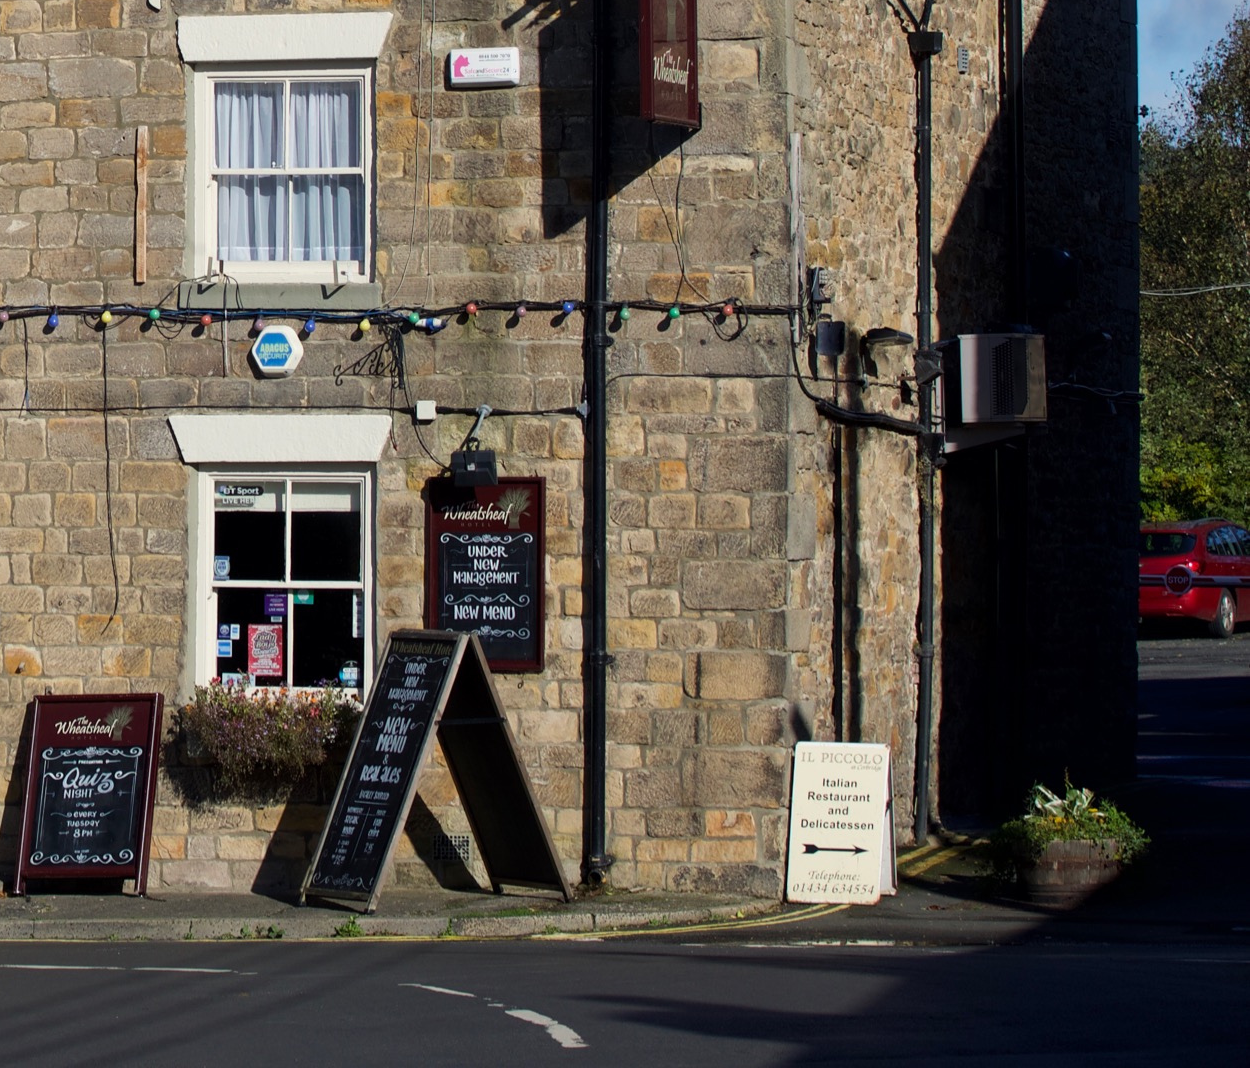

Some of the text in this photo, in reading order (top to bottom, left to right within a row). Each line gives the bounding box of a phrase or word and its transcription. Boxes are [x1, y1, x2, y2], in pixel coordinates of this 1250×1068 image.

[653, 53, 690, 94] Wheatsheaf
[260, 343, 289, 352] ABACUS
[237, 487, 259, 495] Sport
[441, 503, 513, 525] Wheatsheaf
[1168, 576, 1189, 584] STOP
[392, 640, 452, 655] Wheatsheaf Hote
[77, 716, 89, 725] The
[54, 718, 118, 738] Wheatsheaf
[801, 752, 883, 765] IL PICCOLO
[62, 766, 115, 794] Quiz
[822, 778, 858, 788] Italian
[63, 788, 95, 799] NIGHT
[807, 791, 871, 802] Restaurant
[827, 806, 849, 816] and
[800, 819, 874, 830] Delicatessen
[808, 870, 861, 883] Telephone:
[792, 883, 875, 895] 01434 634554
